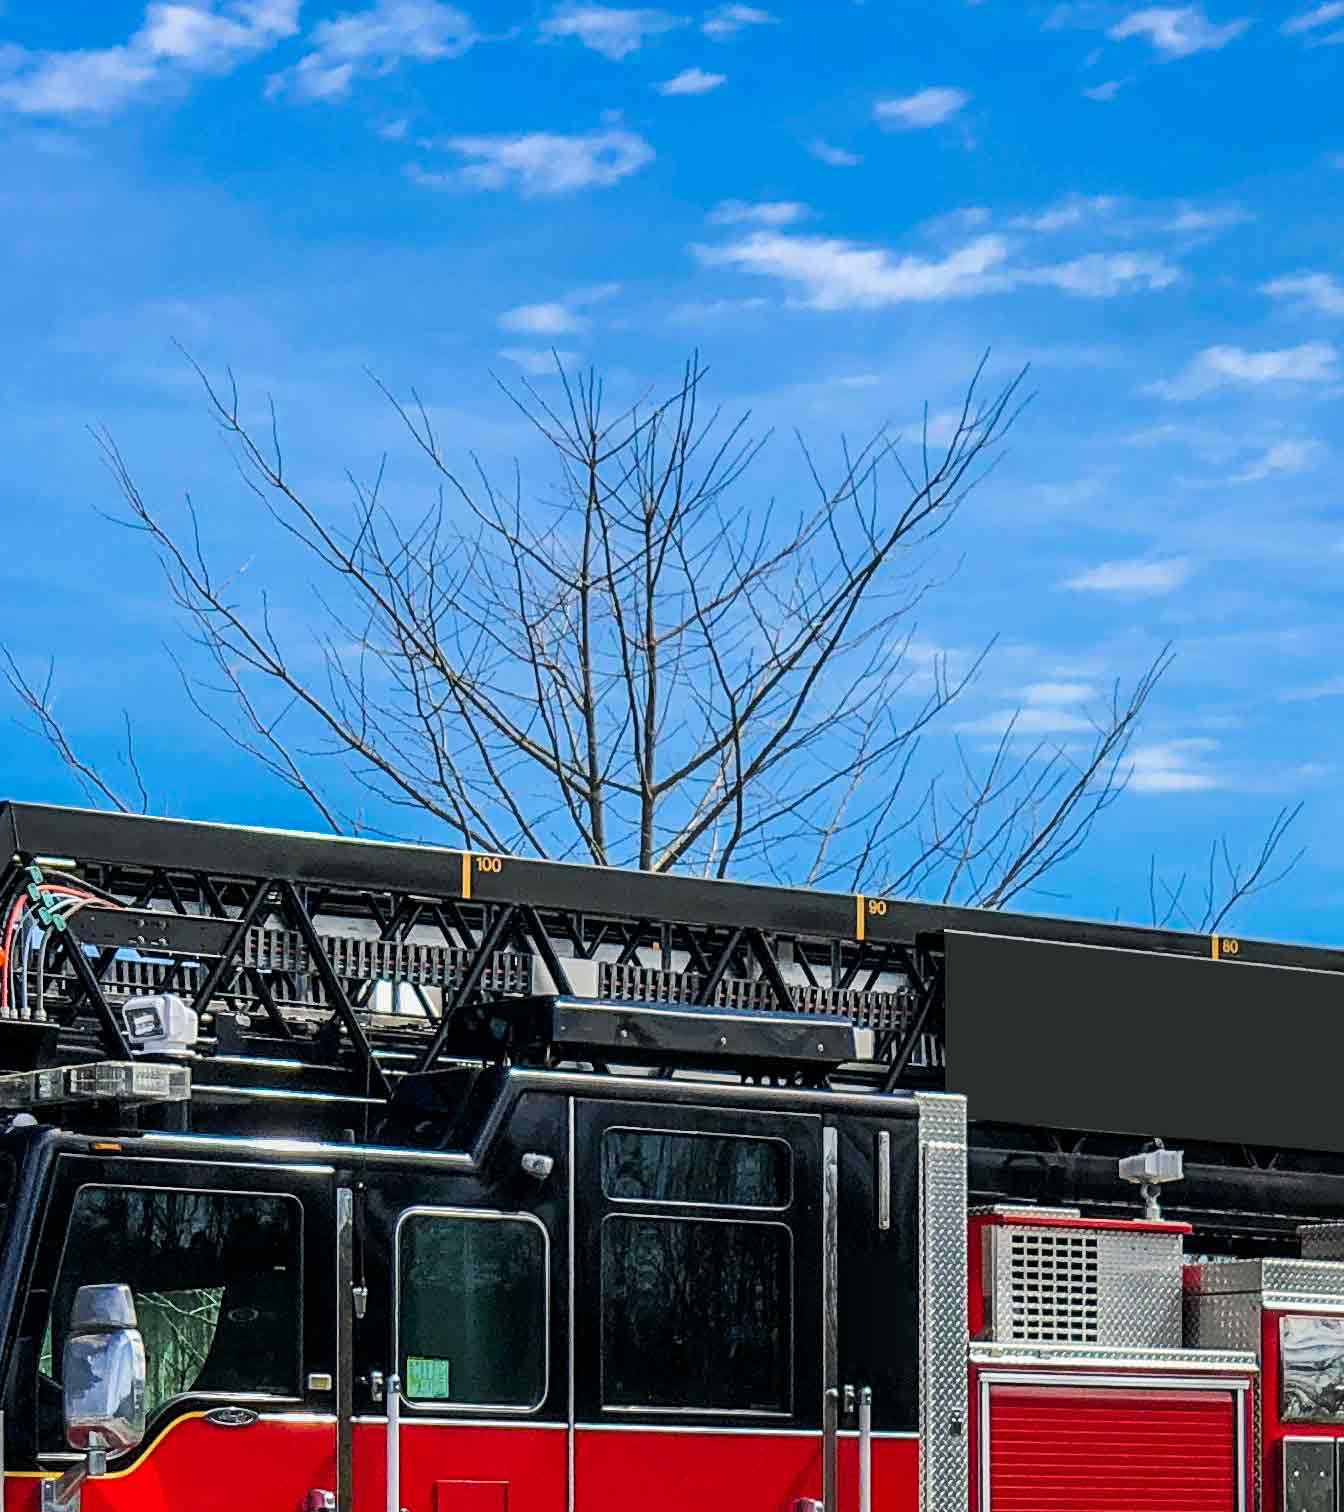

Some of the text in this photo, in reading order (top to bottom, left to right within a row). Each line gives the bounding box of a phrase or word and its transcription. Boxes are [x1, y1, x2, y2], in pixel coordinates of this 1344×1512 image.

[476, 857, 502, 873] 100
[868, 899, 887, 915] 90
[1222, 938, 1239, 955] 80
